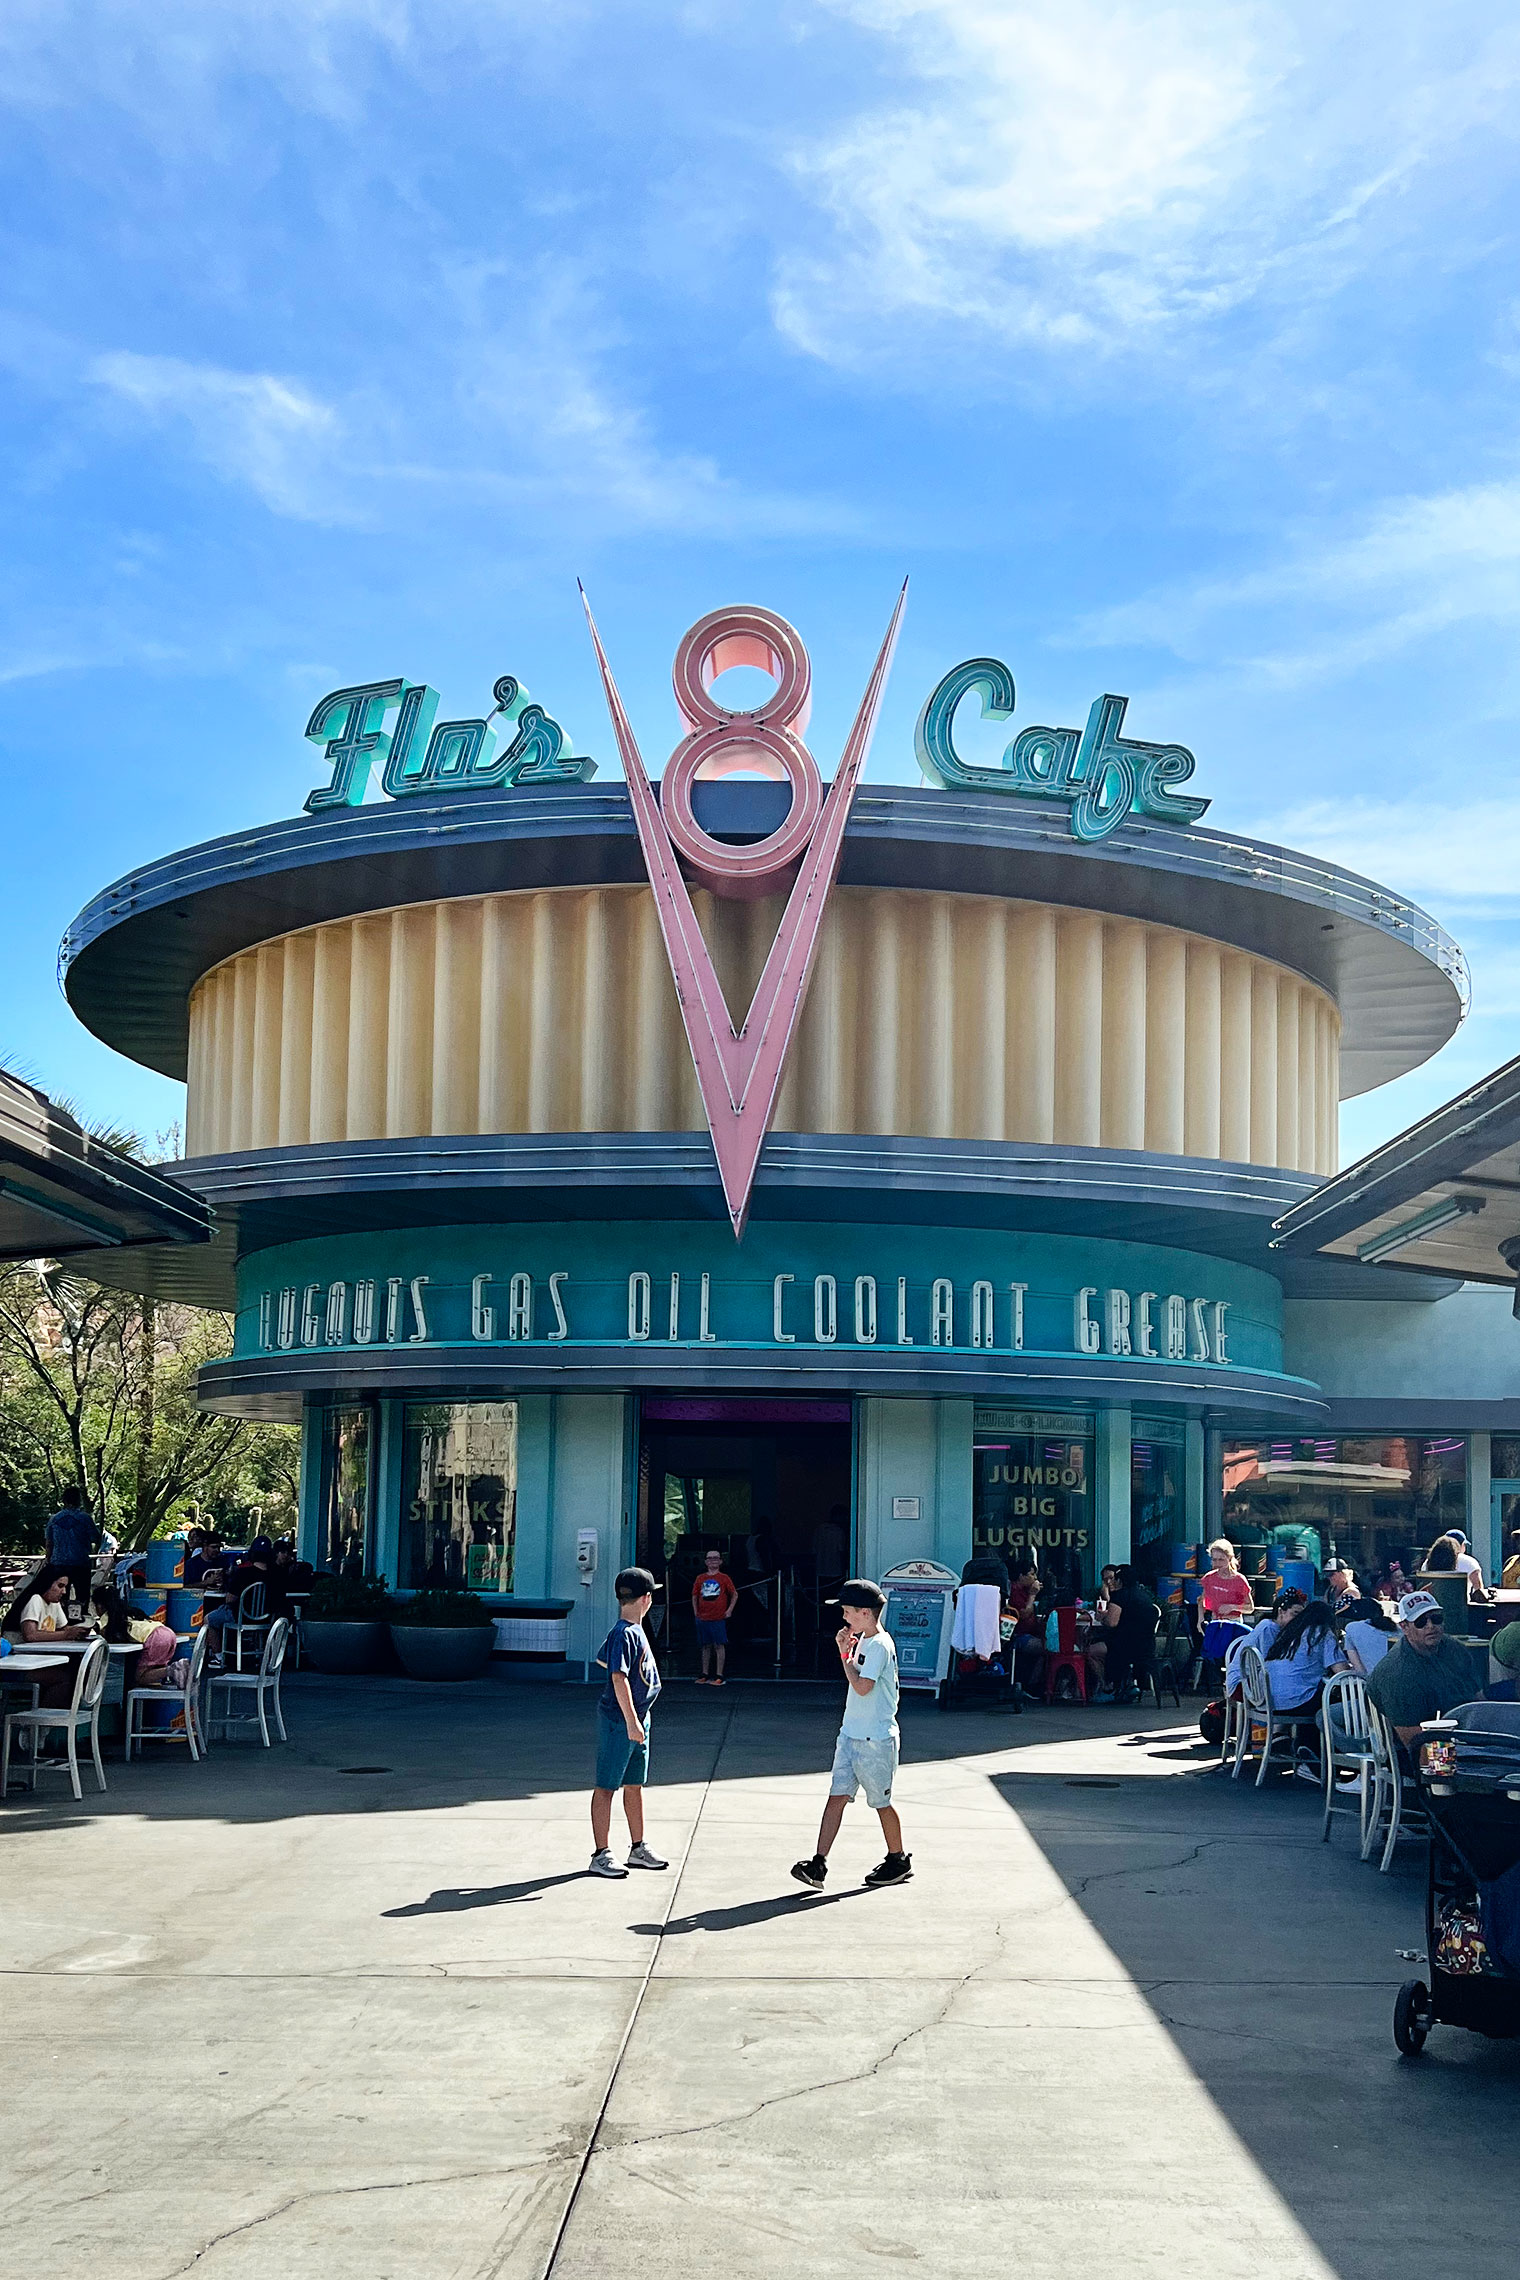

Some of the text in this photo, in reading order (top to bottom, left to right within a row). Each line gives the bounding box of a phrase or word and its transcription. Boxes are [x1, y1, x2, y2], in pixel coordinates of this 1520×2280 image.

[303, 675, 598, 815] Flo's
[260, 1272, 1234, 1364] LUGNUTS GAS OIL COOLANT GREASE
[988, 1465, 1078, 1486] JUMBO
[1013, 1496, 1056, 1516] BIG
[973, 1527, 1089, 1548] LUGNUTS
[1406, 1595, 1432, 1609] USA
